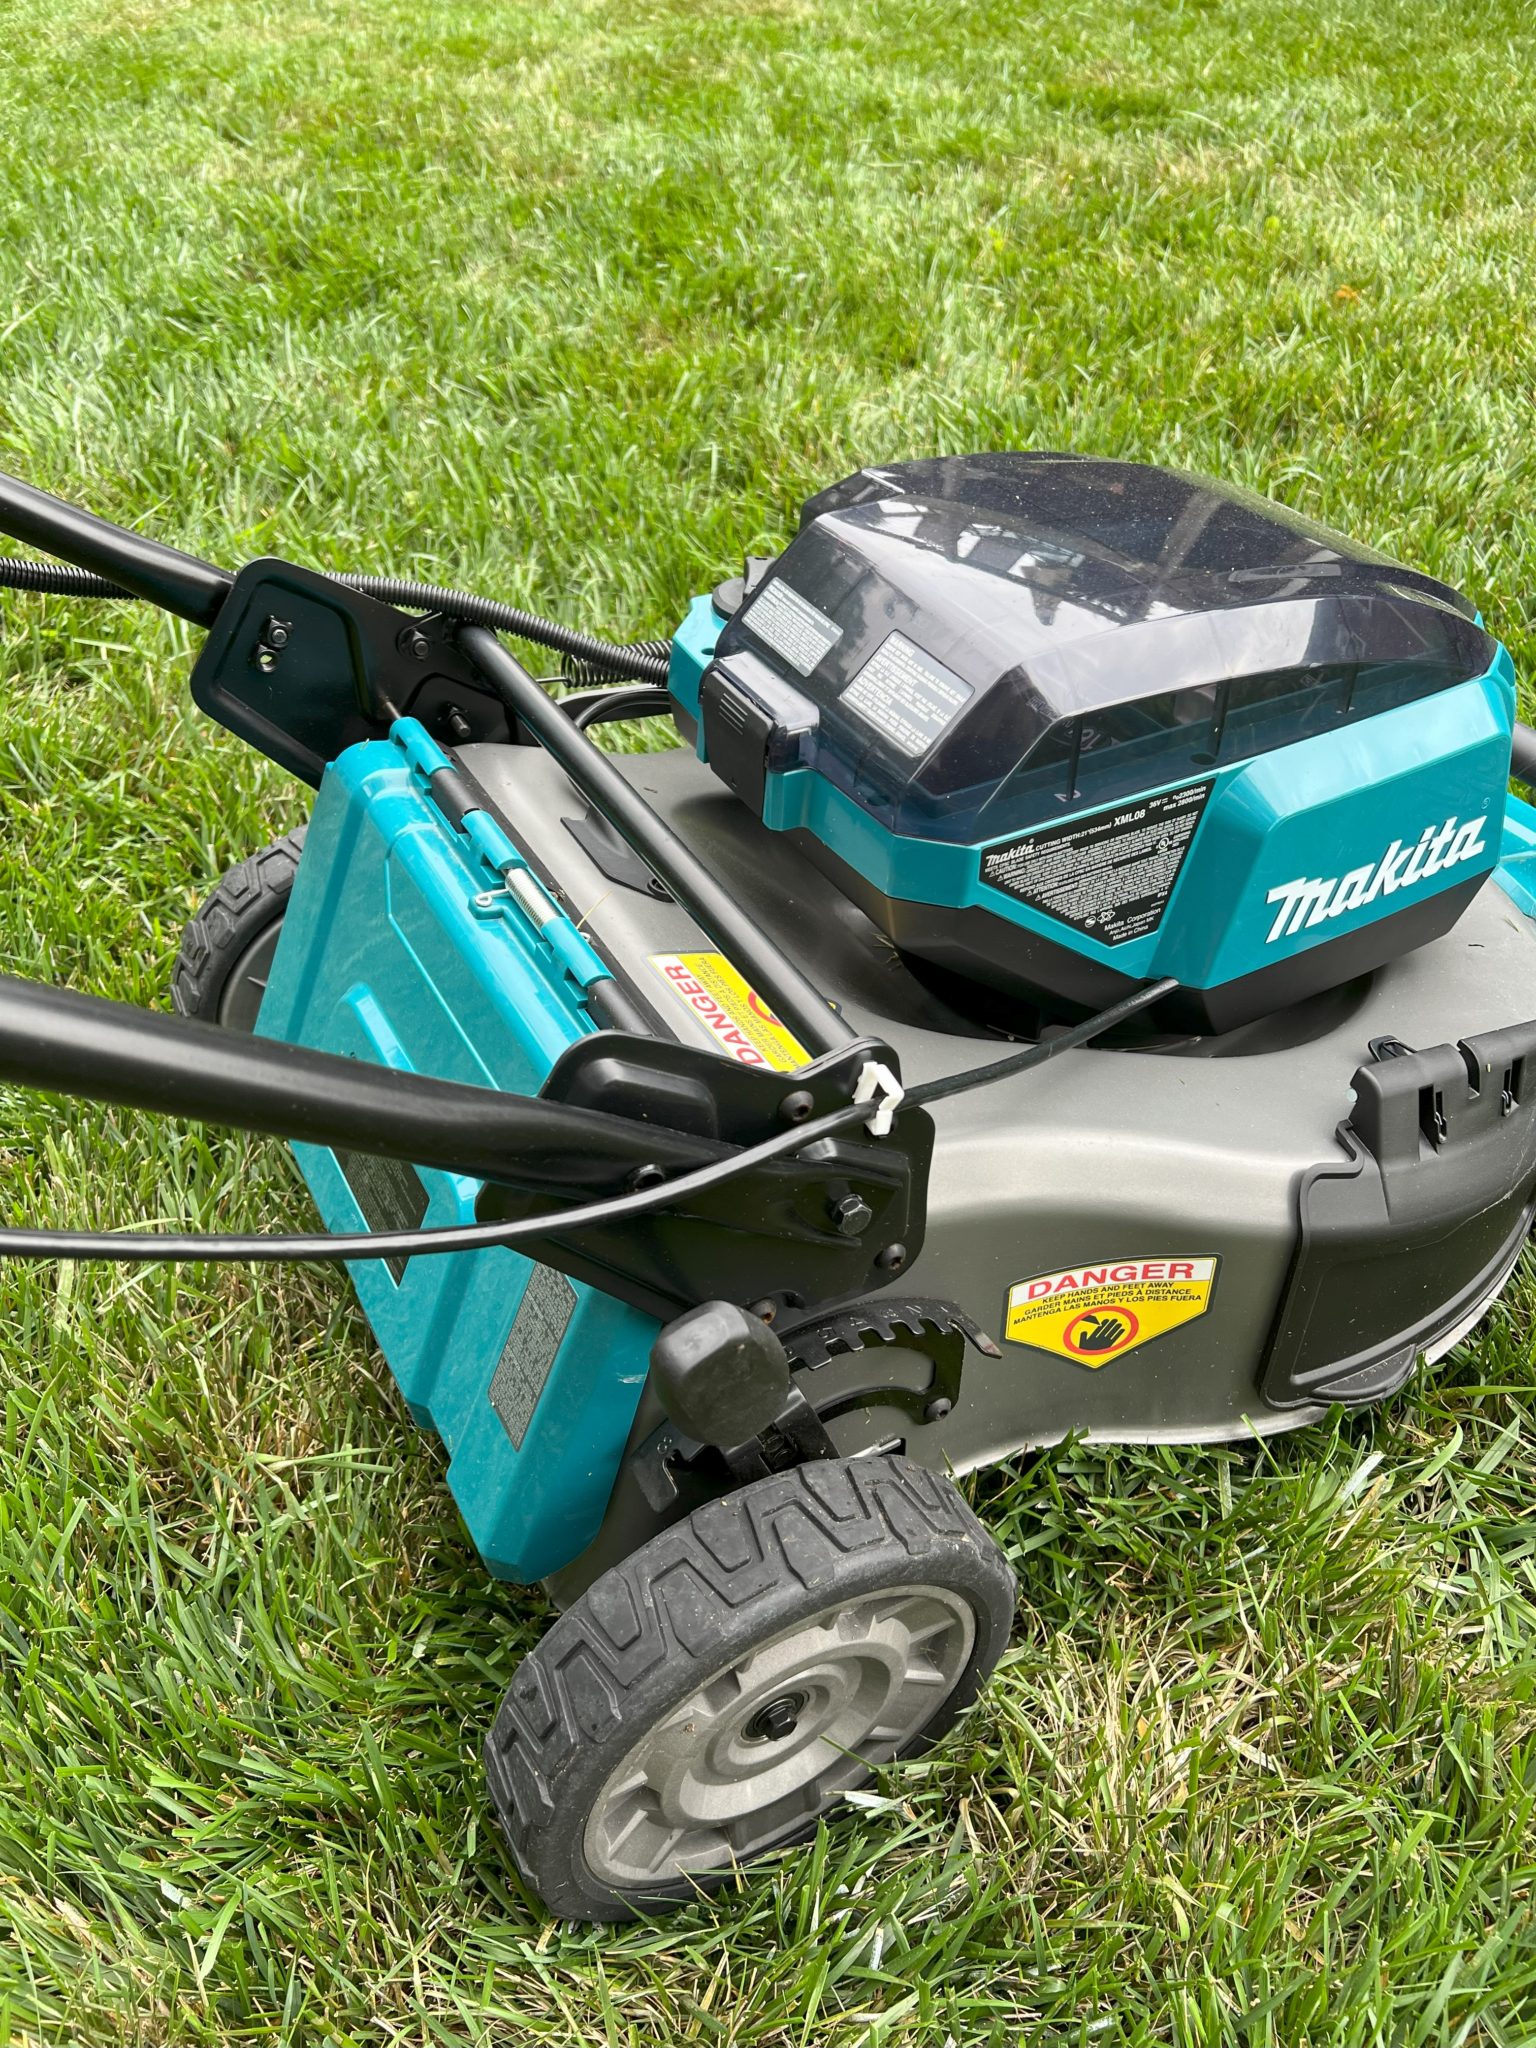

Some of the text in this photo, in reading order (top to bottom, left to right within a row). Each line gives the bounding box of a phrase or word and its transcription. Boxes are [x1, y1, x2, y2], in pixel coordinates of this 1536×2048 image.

[1035, 838, 1061, 851] CUTTING
[1113, 809, 1146, 827] XML08
[1104, 907, 1161, 931] Makita Corporation
[1133, 925, 1149, 933] China
[664, 965, 765, 1065] DANGER
[1027, 1262, 1195, 1300] DANGER
[1042, 1292, 1066, 1303] KEEP
[1067, 1287, 1099, 1298] HANDS
[1100, 1284, 1120, 1293] AND
[1013, 1307, 1062, 1325] MANTENGA
[1063, 1302, 1081, 1311] LAS
[1083, 1299, 1115, 1308] MANOS
[1147, 1294, 1168, 1302] PIES
[1170, 1294, 1202, 1302] FUERA
[1024, 1302, 1061, 1315] GARDER
[1063, 1296, 1091, 1306] MAINS
[1107, 1290, 1136, 1298] PIEDS
